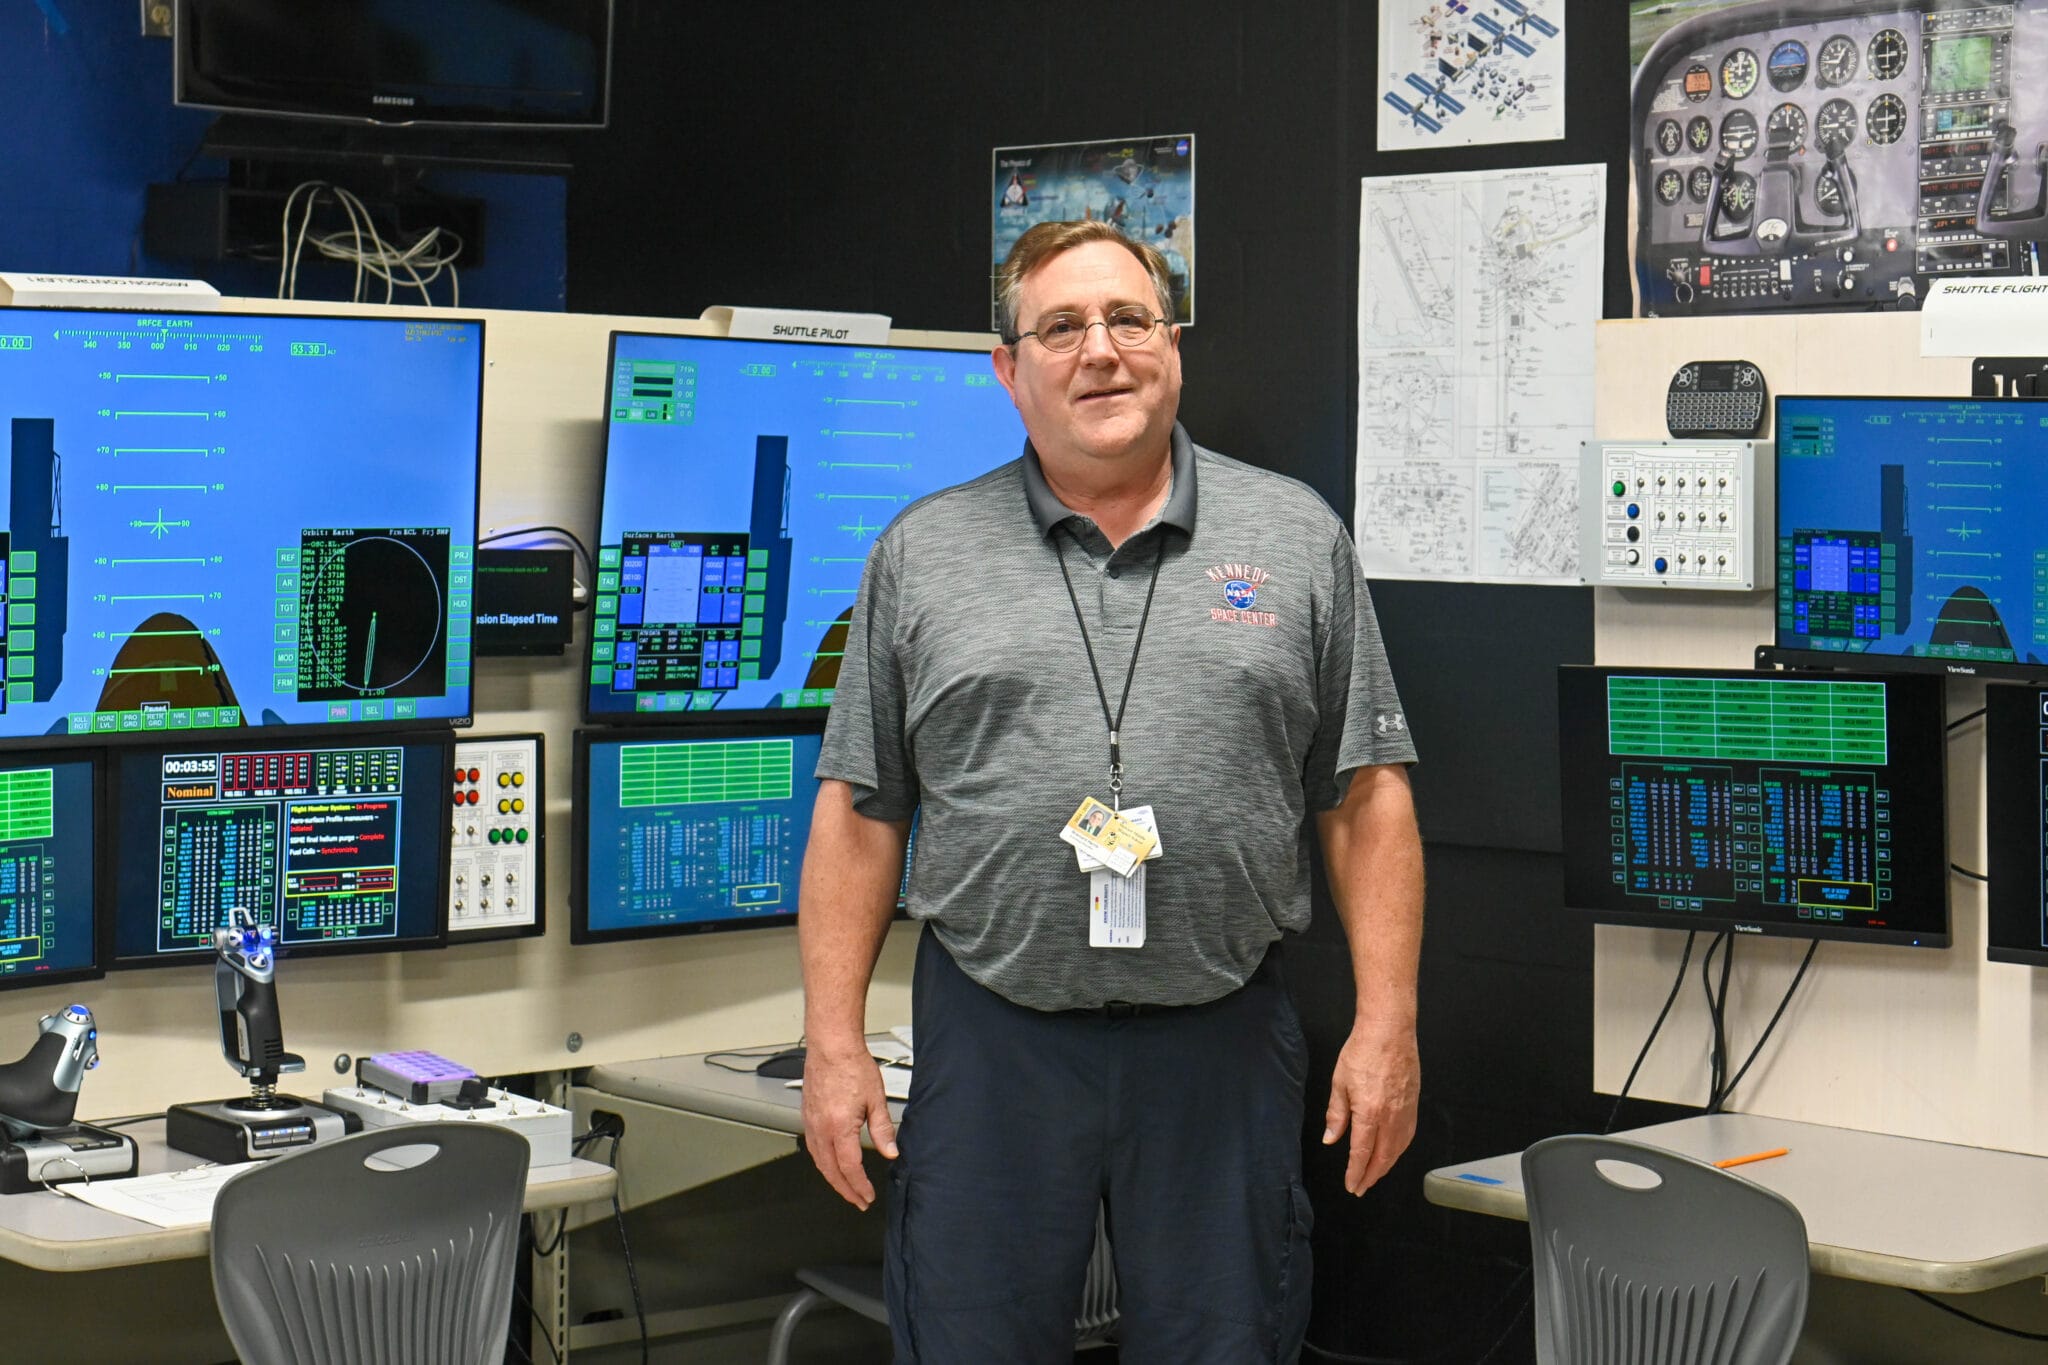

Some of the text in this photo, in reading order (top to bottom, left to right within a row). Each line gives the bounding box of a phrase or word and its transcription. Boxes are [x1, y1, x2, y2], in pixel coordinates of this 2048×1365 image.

[1942, 284, 2048, 294] SHUTTLE FLIGHT
[167, 320, 193, 328] EARTH
[772, 325, 849, 339] SHUTTLE PILOT
[184, 343, 198, 351] 010
[281, 554, 295, 562] REF
[454, 551, 469, 560] PRJ
[1205, 563, 1271, 584] KENNEDY
[282, 579, 293, 587] AR
[454, 575, 467, 584] DST
[1226, 589, 1254, 598] NASA
[280, 604, 294, 612] TGT
[452, 600, 468, 608] HUD
[500, 613, 535, 627] Elapsed
[536, 613, 558, 625] Time
[1210, 607, 1277, 627] SPACE CENTER
[277, 653, 294, 662] MOD
[1946, 665, 1976, 675] ViewSonic
[277, 679, 293, 687] FRM
[331, 707, 347, 716] PWR
[366, 706, 379, 715] SEL
[397, 705, 412, 714] MNU
[449, 717, 471, 726] VIZIO
[165, 760, 216, 773] 00:03:55
[167, 785, 214, 798] Nominal
[359, 833, 385, 841] Complete
[321, 846, 359, 855] Synchronizing
